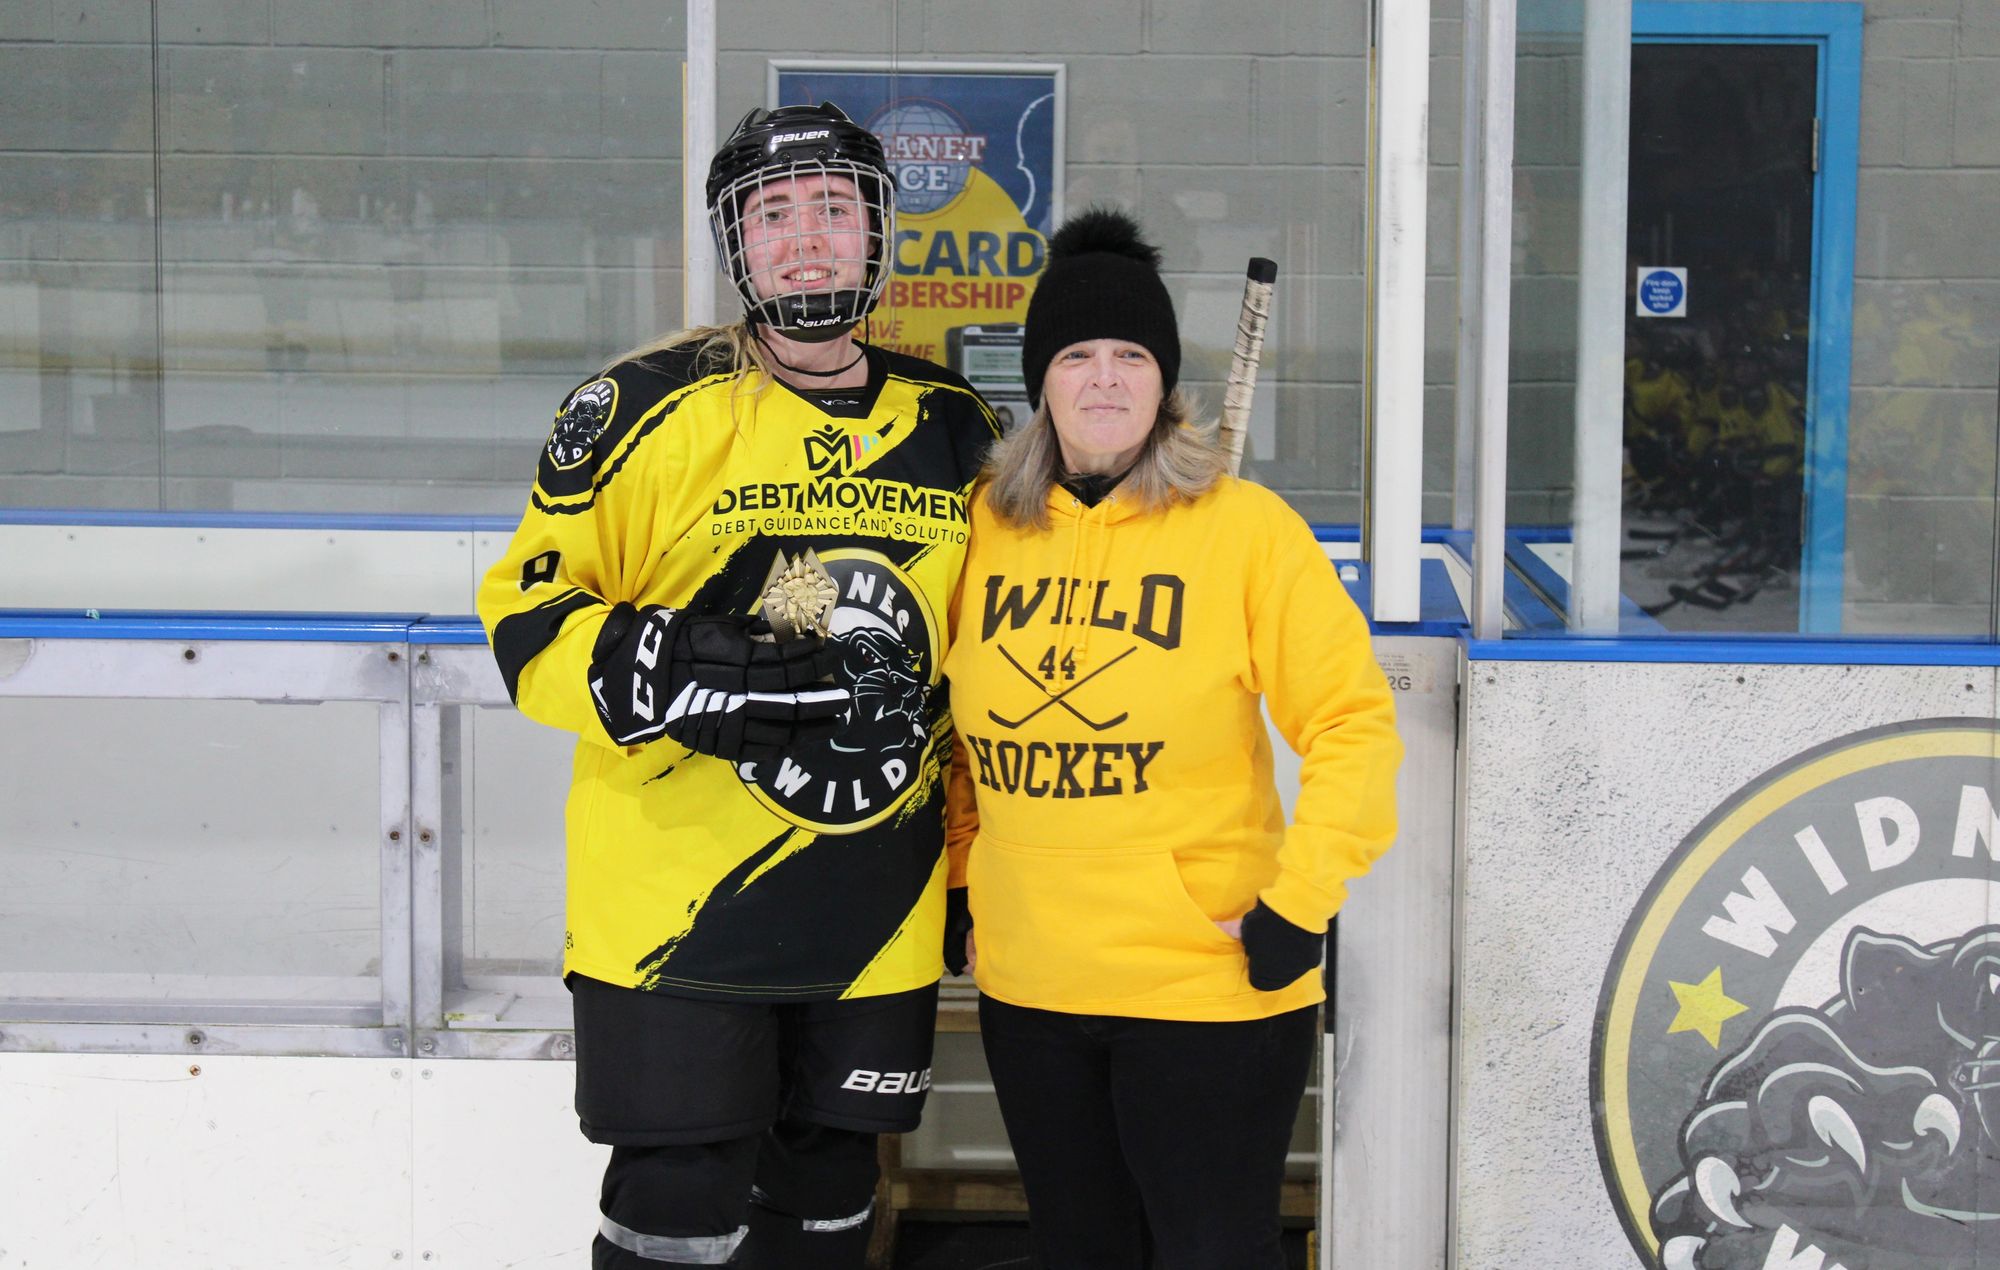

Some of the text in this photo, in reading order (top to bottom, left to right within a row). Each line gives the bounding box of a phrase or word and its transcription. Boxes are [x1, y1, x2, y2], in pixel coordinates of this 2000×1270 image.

[771, 130, 830, 144] BAUER
[894, 229, 1046, 277] CARD
[796, 315, 842, 328] BAUER
[713, 482, 968, 524] DEBT MOVEMEN
[712, 517, 967, 544] DEBT GUIDANCE AND SOLUTIO
[982, 573, 1185, 650] WILD
[1038, 645, 1077, 680] 44
[774, 757, 908, 813] WILD
[966, 734, 1165, 799] HOCKEY
[1701, 784, 2000, 959] WIDN
